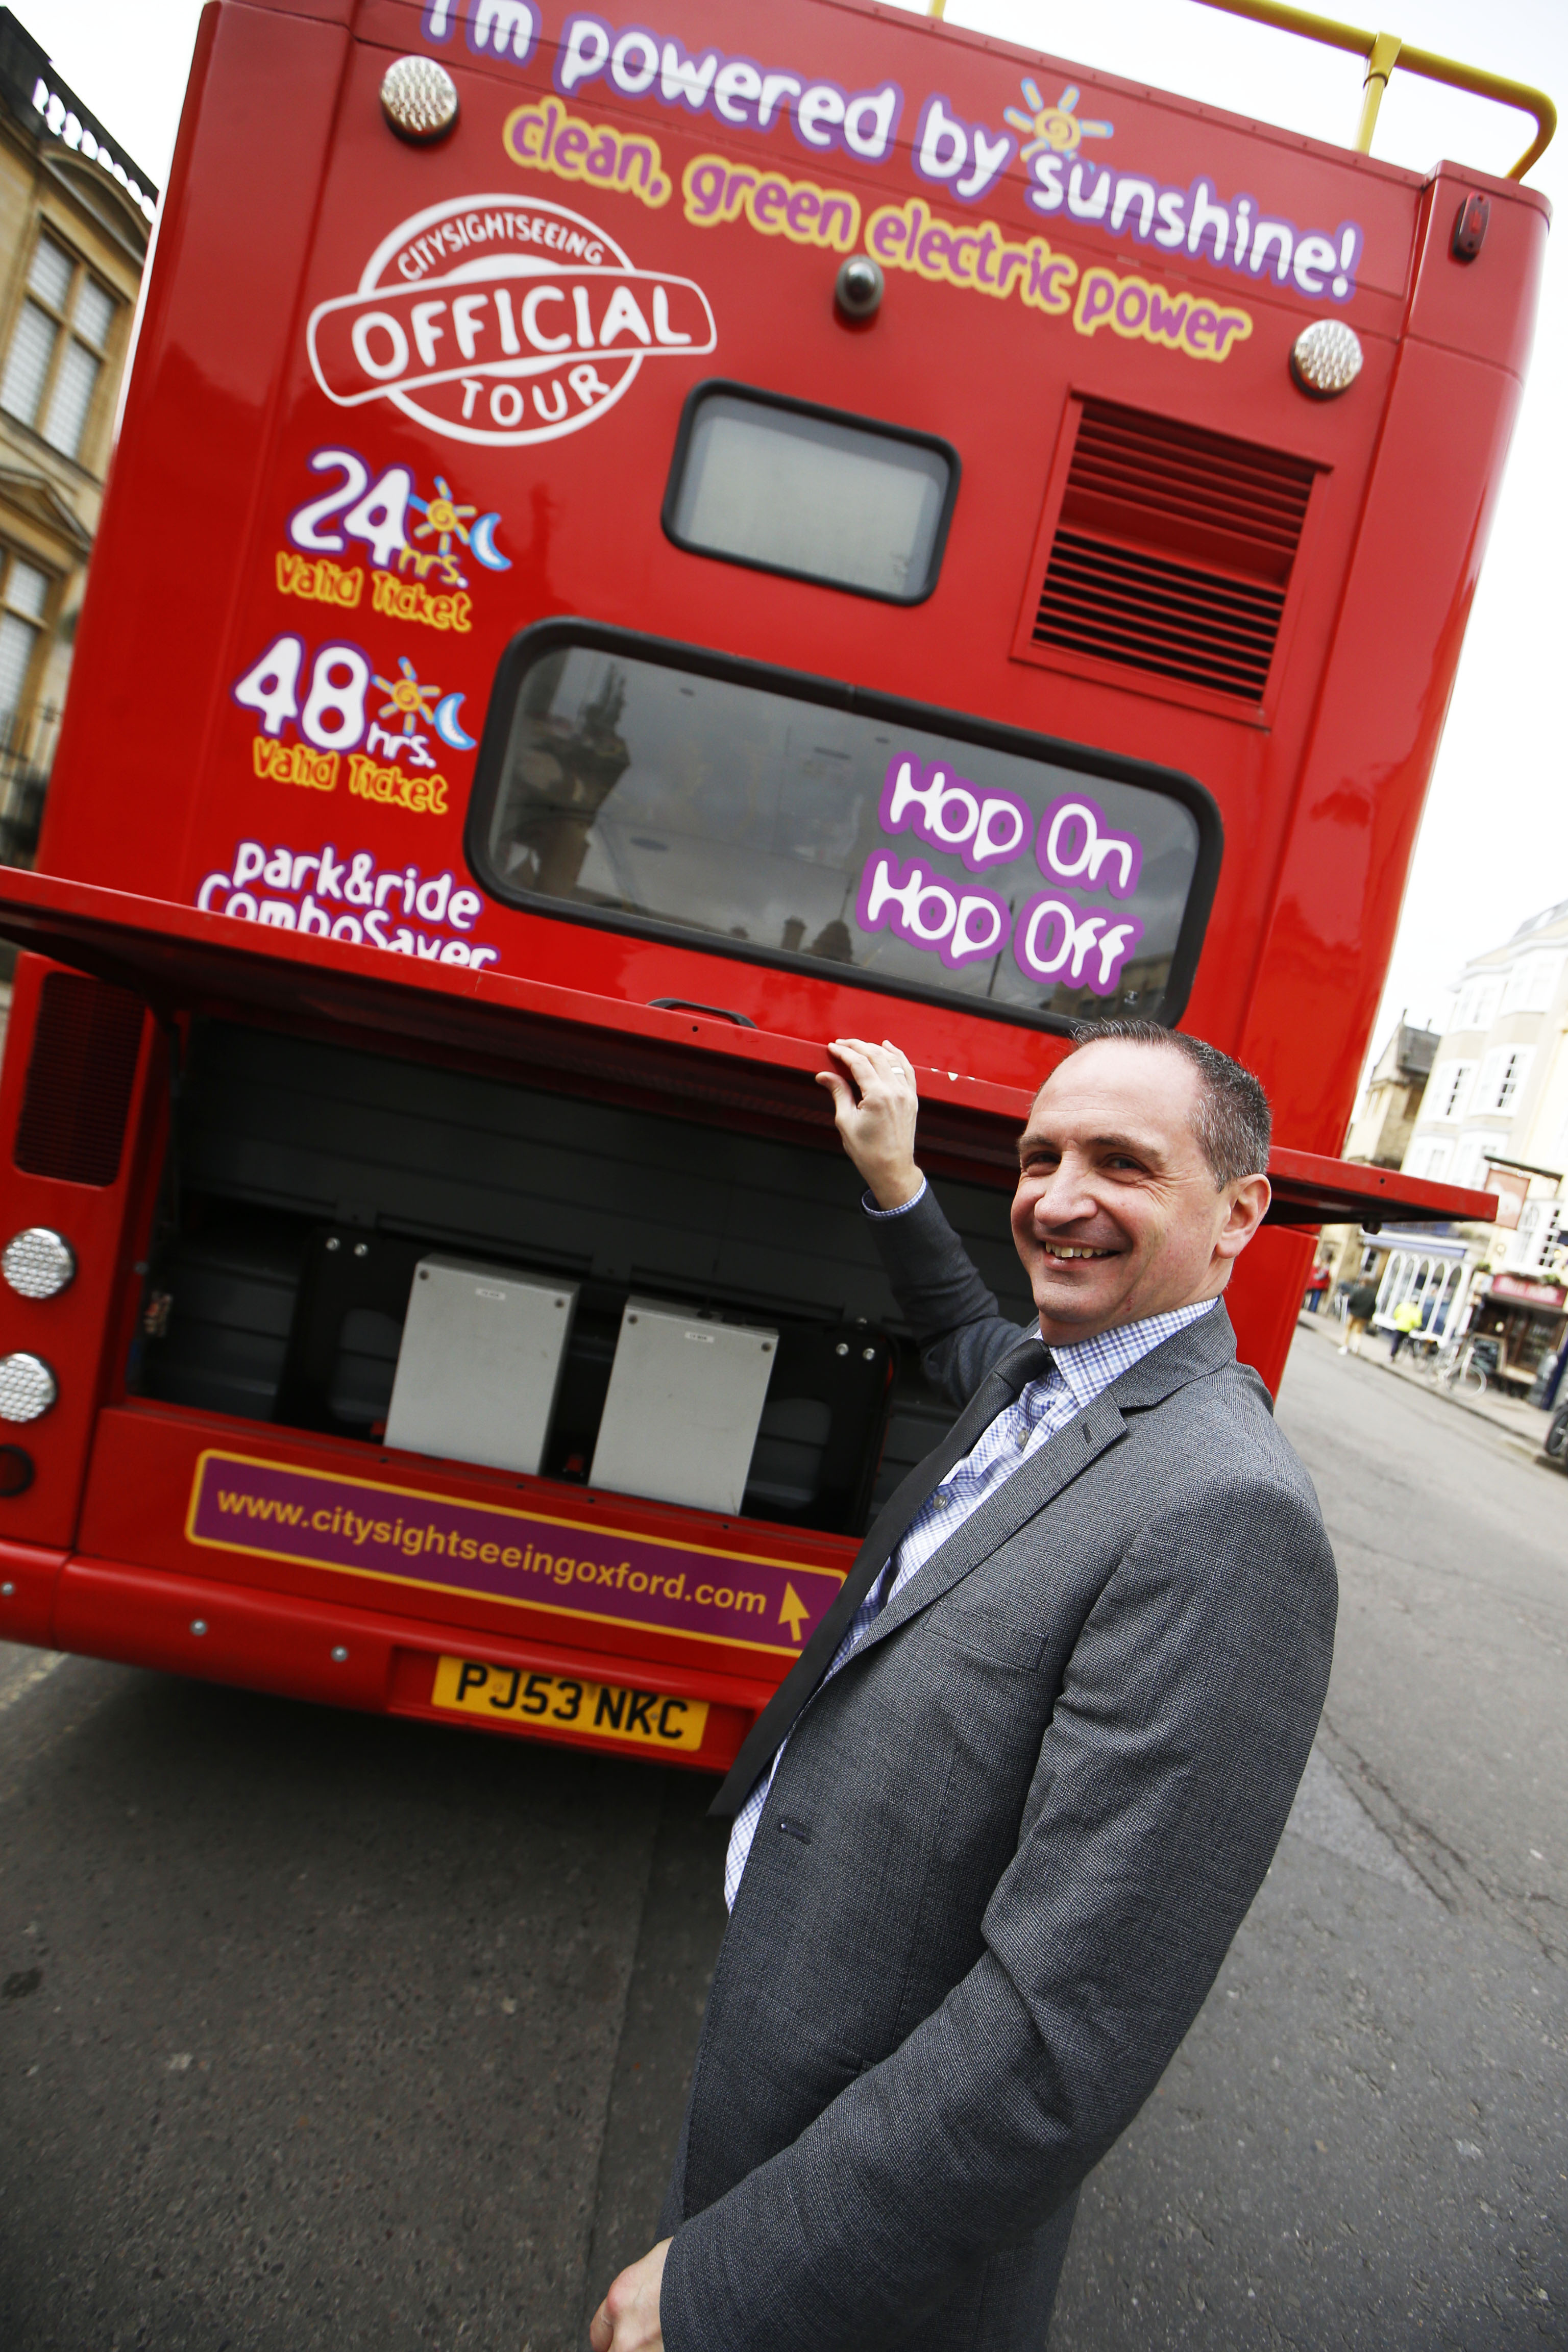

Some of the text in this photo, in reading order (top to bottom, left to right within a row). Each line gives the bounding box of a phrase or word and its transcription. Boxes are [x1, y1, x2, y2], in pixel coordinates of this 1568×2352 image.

[429, 0, 1357, 298] Im powered by sunshine!
[398, 212, 604, 281] CITYSIGHTSEEING
[689, 160, 853, 243] green
[872, 205, 1071, 304] electric
[1080, 274, 1245, 353] power
[351, 285, 692, 380] OFFICIAL
[460, 364, 610, 427] TOUR
[276, 551, 472, 633] Valid Ticket
[253, 736, 448, 815] Valid Ticket
[889, 761, 1133, 889] Hop On
[233, 842, 481, 929] park&ride
[867, 860, 1135, 985] Hop Off
[217, 1489, 768, 1615] www.citysightseeingoxford.com
[456, 1662, 689, 1739] PJ53 NKC
